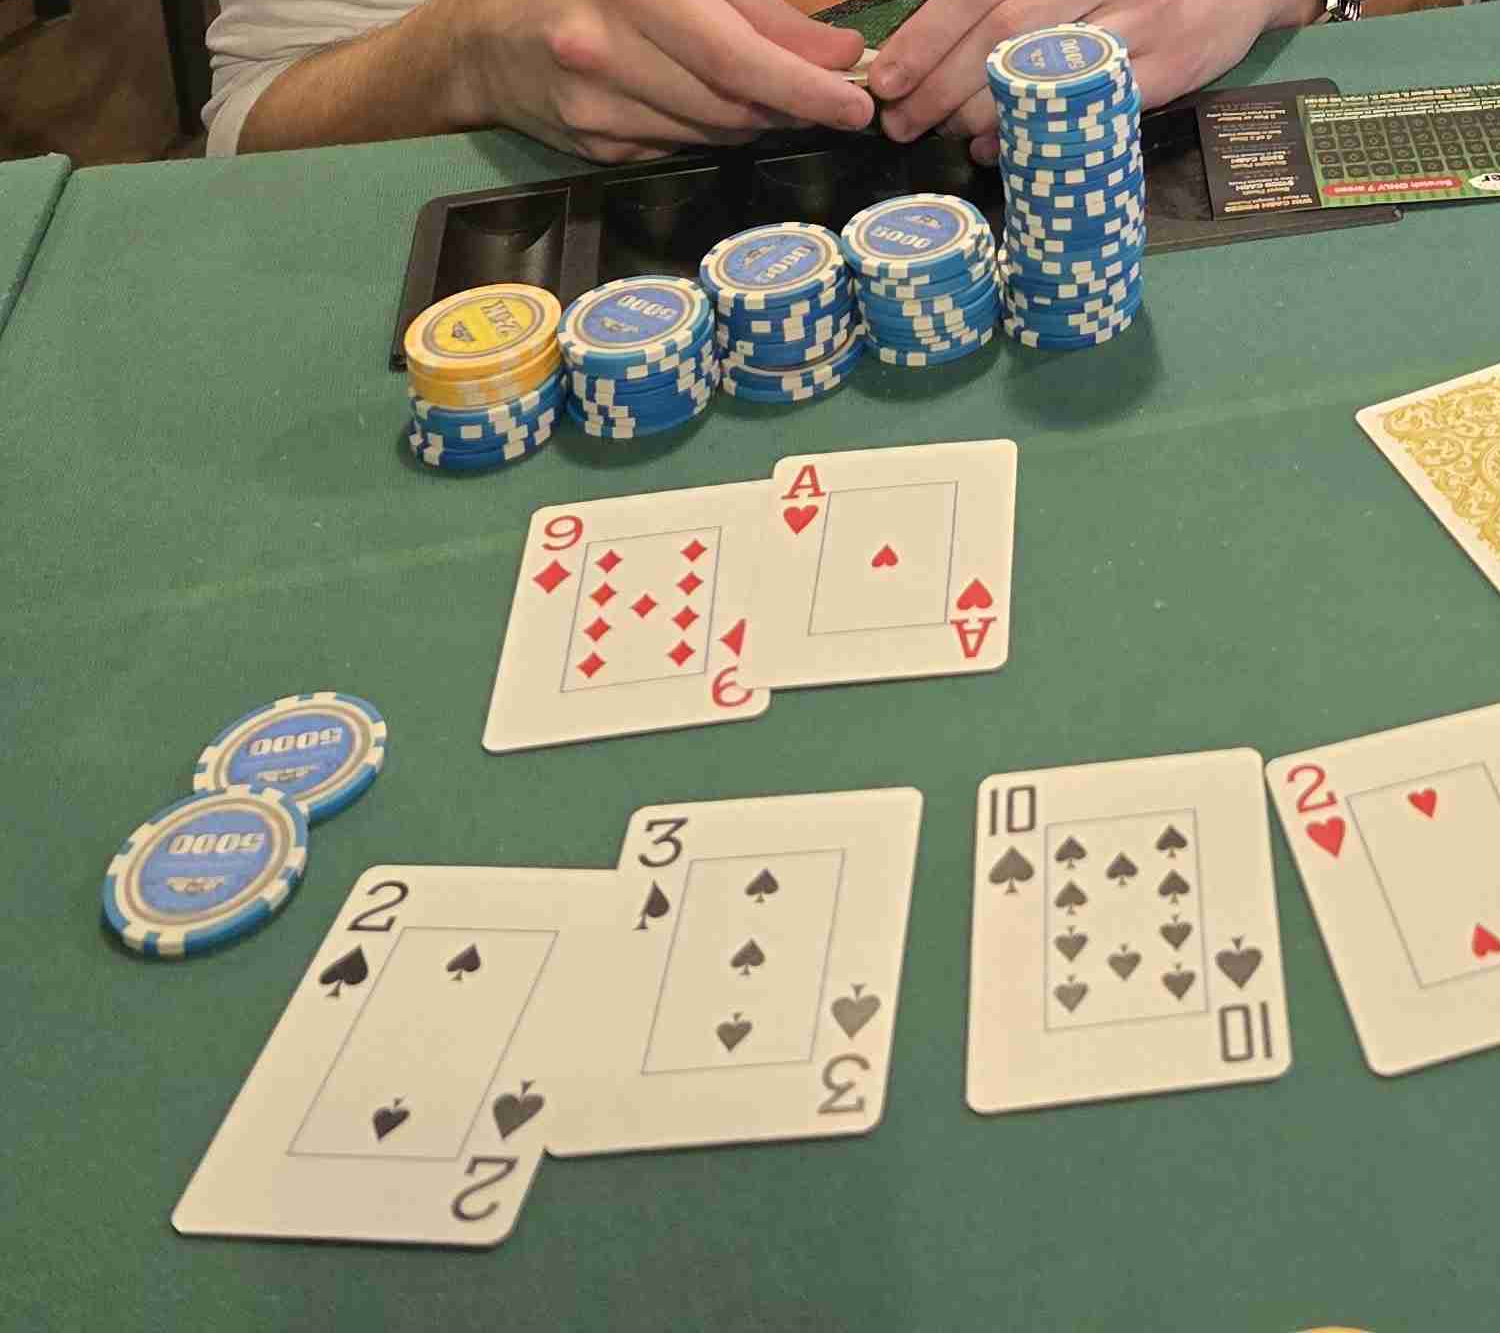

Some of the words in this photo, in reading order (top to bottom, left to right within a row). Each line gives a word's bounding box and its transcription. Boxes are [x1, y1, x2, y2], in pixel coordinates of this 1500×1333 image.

[781, 465, 826, 500] A
[541, 515, 584, 551] 9
[950, 617, 997, 658] A
[248, 727, 344, 757] 5000
[989, 784, 1037, 837] 10
[1287, 763, 1338, 815] 2
[169, 833, 266, 855] 5000
[638, 817, 689, 869] 3
[347, 880, 411, 933] 2
[1219, 1001, 1275, 1064] 10
[817, 1053, 873, 1115] 3
[450, 1156, 519, 1222] 2
